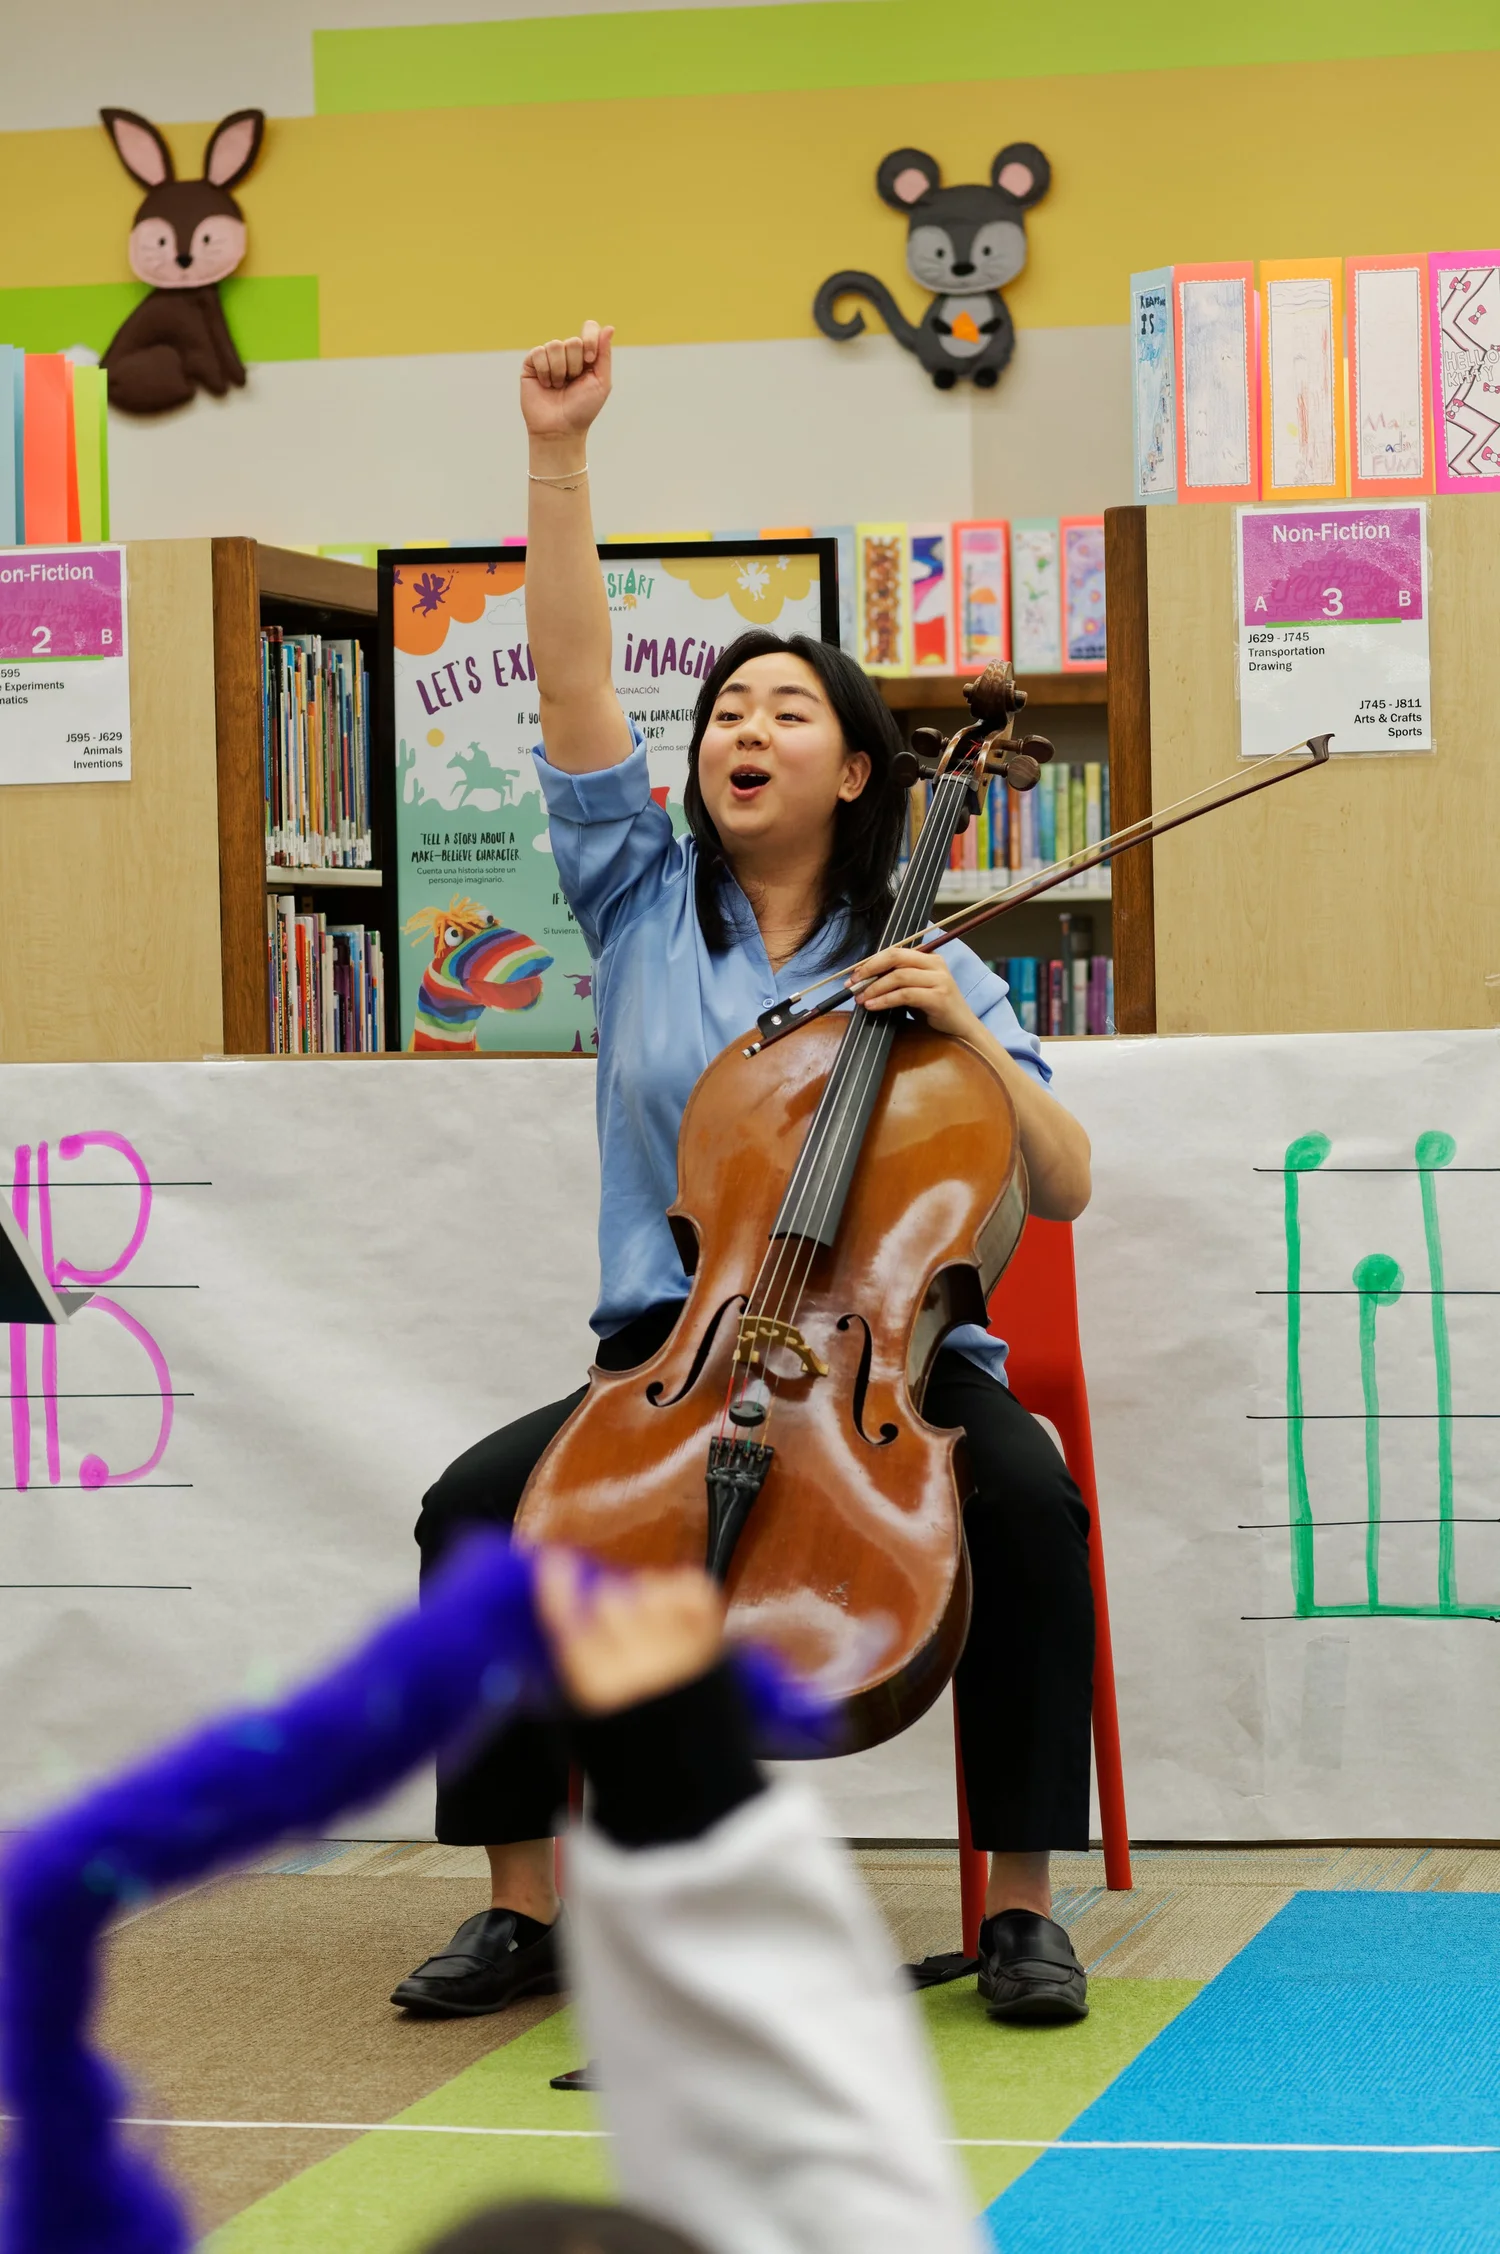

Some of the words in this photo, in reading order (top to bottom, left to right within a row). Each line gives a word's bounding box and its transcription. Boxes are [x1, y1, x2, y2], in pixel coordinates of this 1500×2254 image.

[1445, 349, 1500, 371] HELLO
[1272, 522, 1391, 543] Non-Fiction
[607, 567, 655, 599] START
[1254, 596, 1268, 612] A
[1322, 587, 1344, 617] 3
[1399, 590, 1412, 607] B
[31, 625, 52, 654] 2
[101, 628, 113, 645] B
[1247, 633, 1275, 644] J629
[1283, 631, 1310, 643] J745
[1247, 646, 1326, 658] Transportation
[1248, 661, 1293, 672] Drawing
[4, 681, 65, 693] Experiments
[415, 655, 482, 715] LET'S
[1359, 699, 1387, 710] J745
[1395, 698, 1422, 709] J811
[517, 712, 525, 725] IF
[1353, 714, 1376, 724] Arts
[1378, 713, 1388, 723] &
[1390, 712, 1422, 723] Crafts
[66, 733, 91, 743] J595
[98, 731, 123, 742] J629
[1388, 727, 1423, 738] Sports
[83, 745, 123, 755] Animals
[73, 759, 123, 769] Inventions
[420, 833, 441, 845] TELL
[444, 833, 450, 845] A
[453, 832, 477, 845] STORY
[480, 831, 506, 845] ABOUT
[509, 832, 515, 844] A
[416, 867, 442, 875] Cuenta
[485, 866, 506, 874] sobre
[428, 876, 463, 885] personaje
[464, 876, 505, 885] imaginario.
[552, 893, 560, 905] IF
